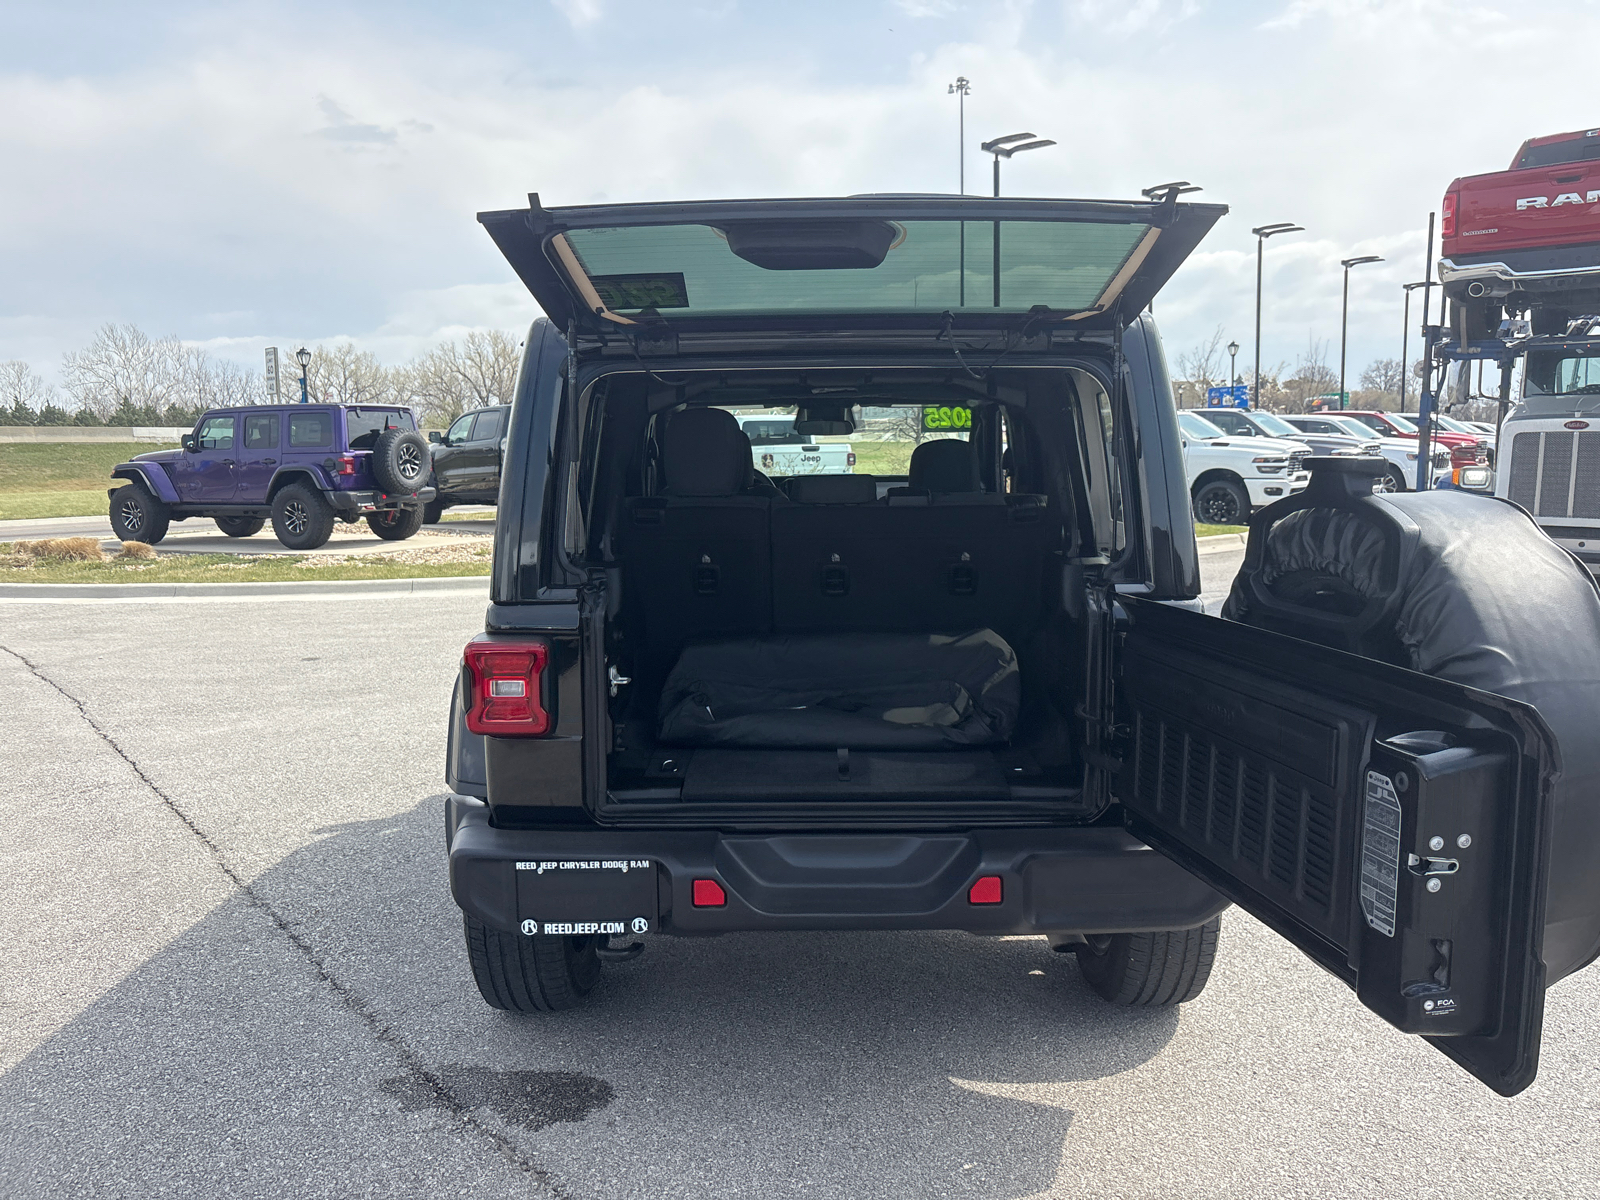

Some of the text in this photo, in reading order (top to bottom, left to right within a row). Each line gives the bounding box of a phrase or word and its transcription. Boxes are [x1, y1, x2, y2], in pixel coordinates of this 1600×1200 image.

[801, 454, 821, 463] Jeep
[516, 860, 650, 870] REED JEEP CHRYSLER DODGE RAM
[544, 922, 625, 935] REEDJEEP.COM
